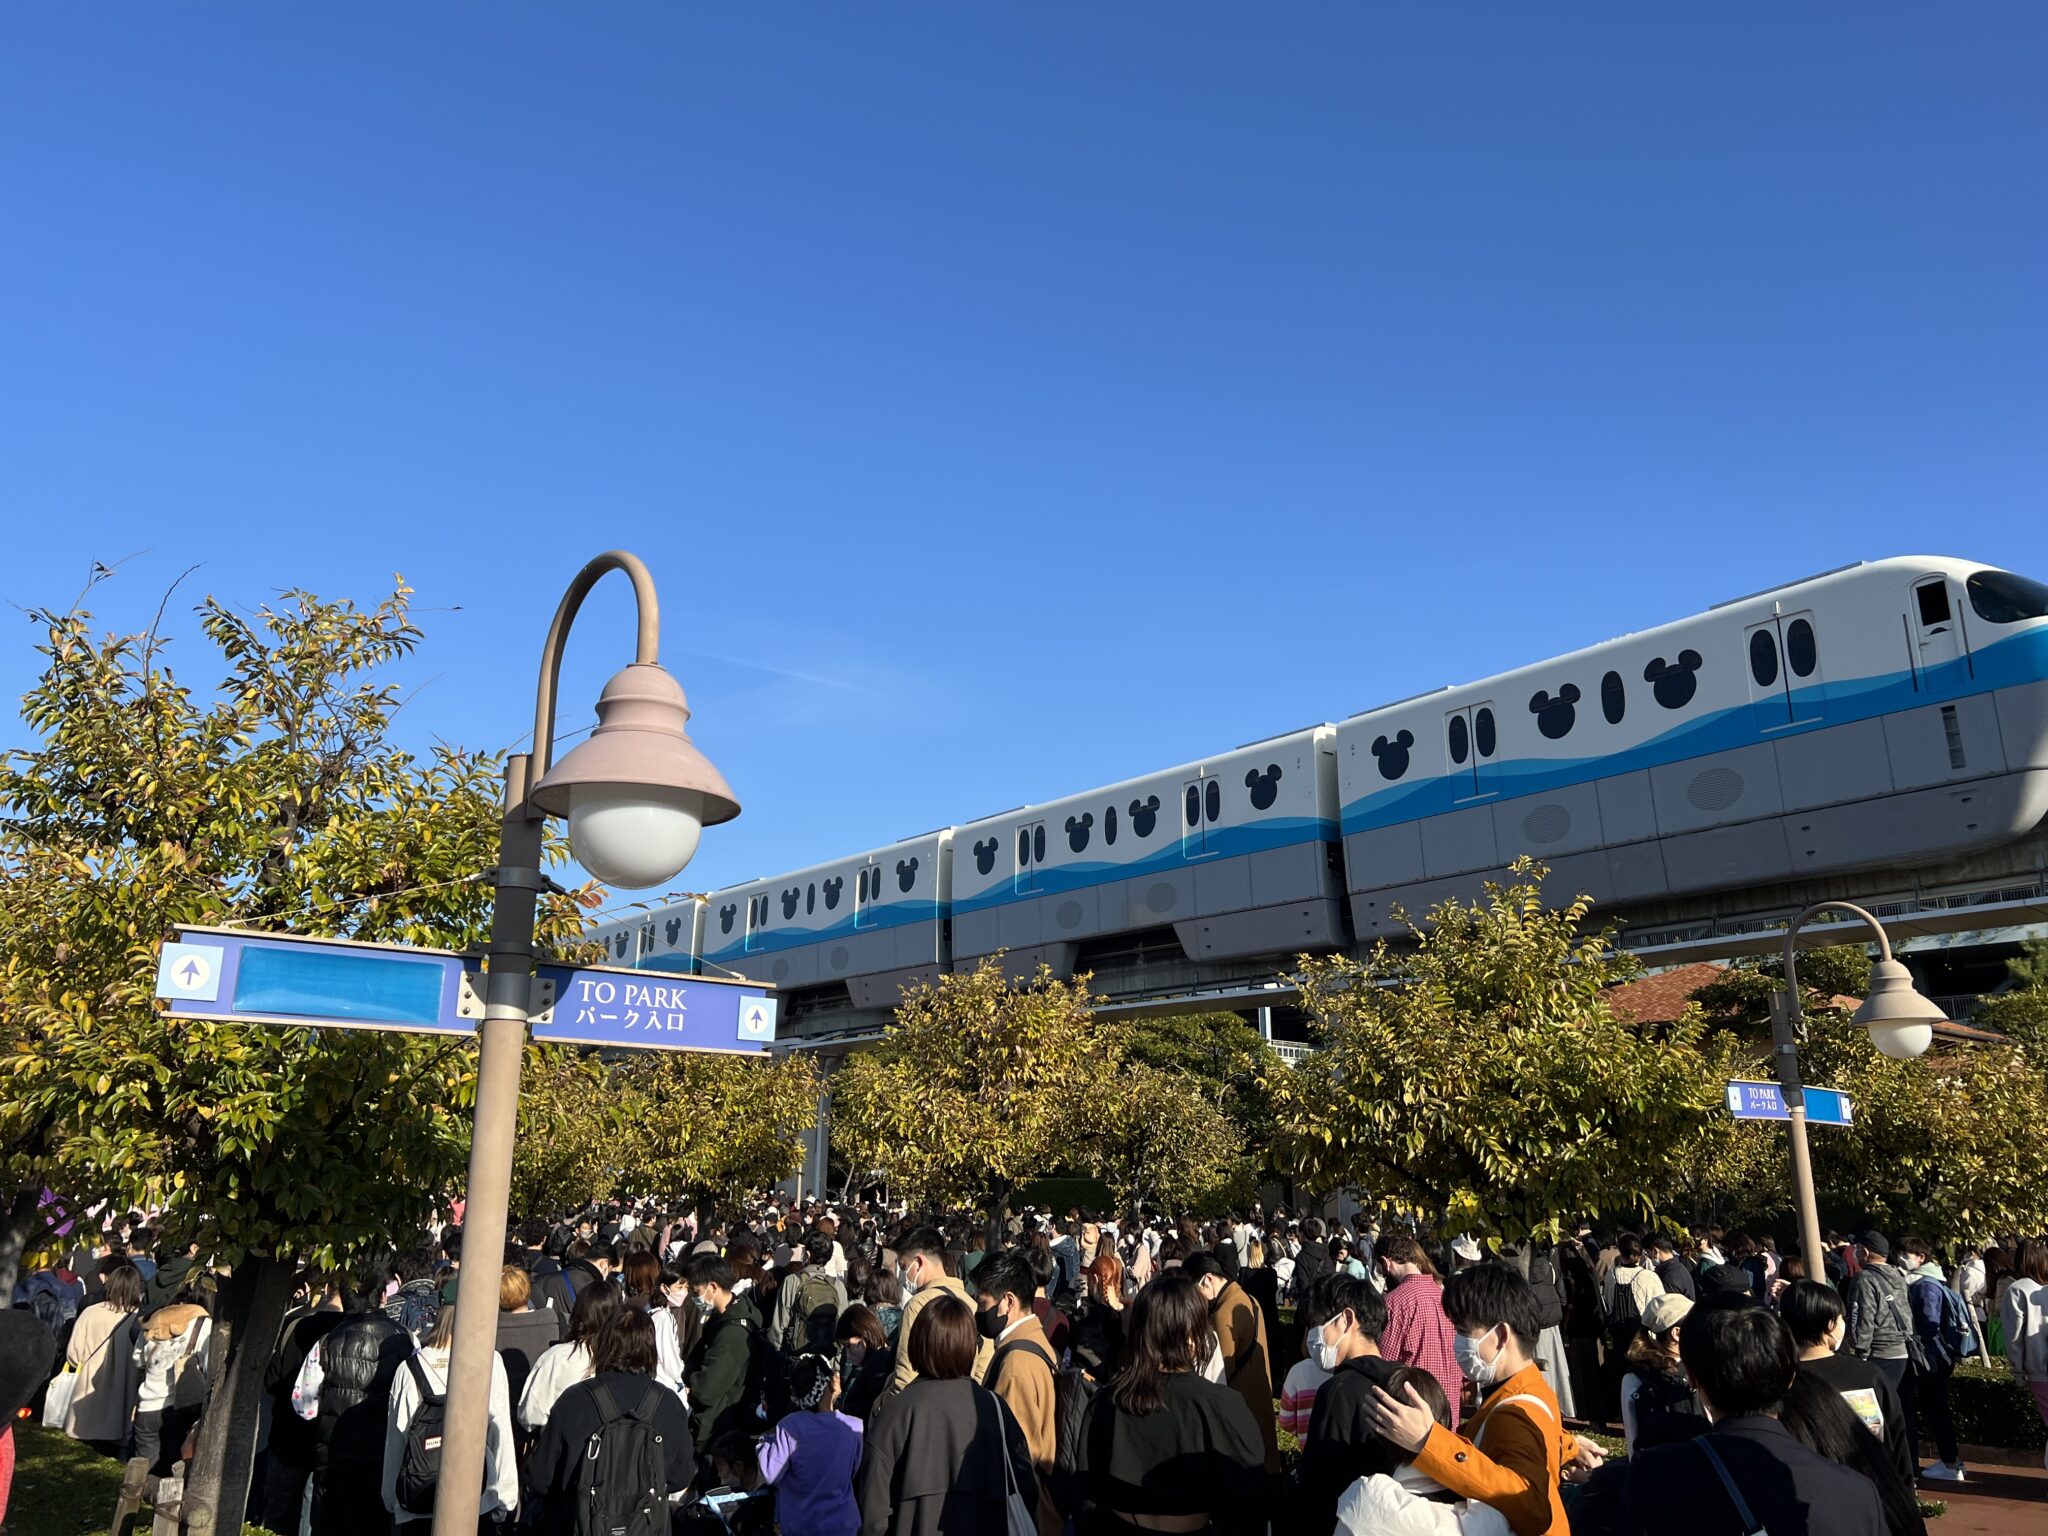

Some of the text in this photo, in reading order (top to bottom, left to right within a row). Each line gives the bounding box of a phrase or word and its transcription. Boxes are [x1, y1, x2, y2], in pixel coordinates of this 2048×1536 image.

[578, 979, 687, 1010] TO PARK
[576, 1006, 684, 1031] パーク入口
[1748, 1087, 1776, 1099] TO PARK
